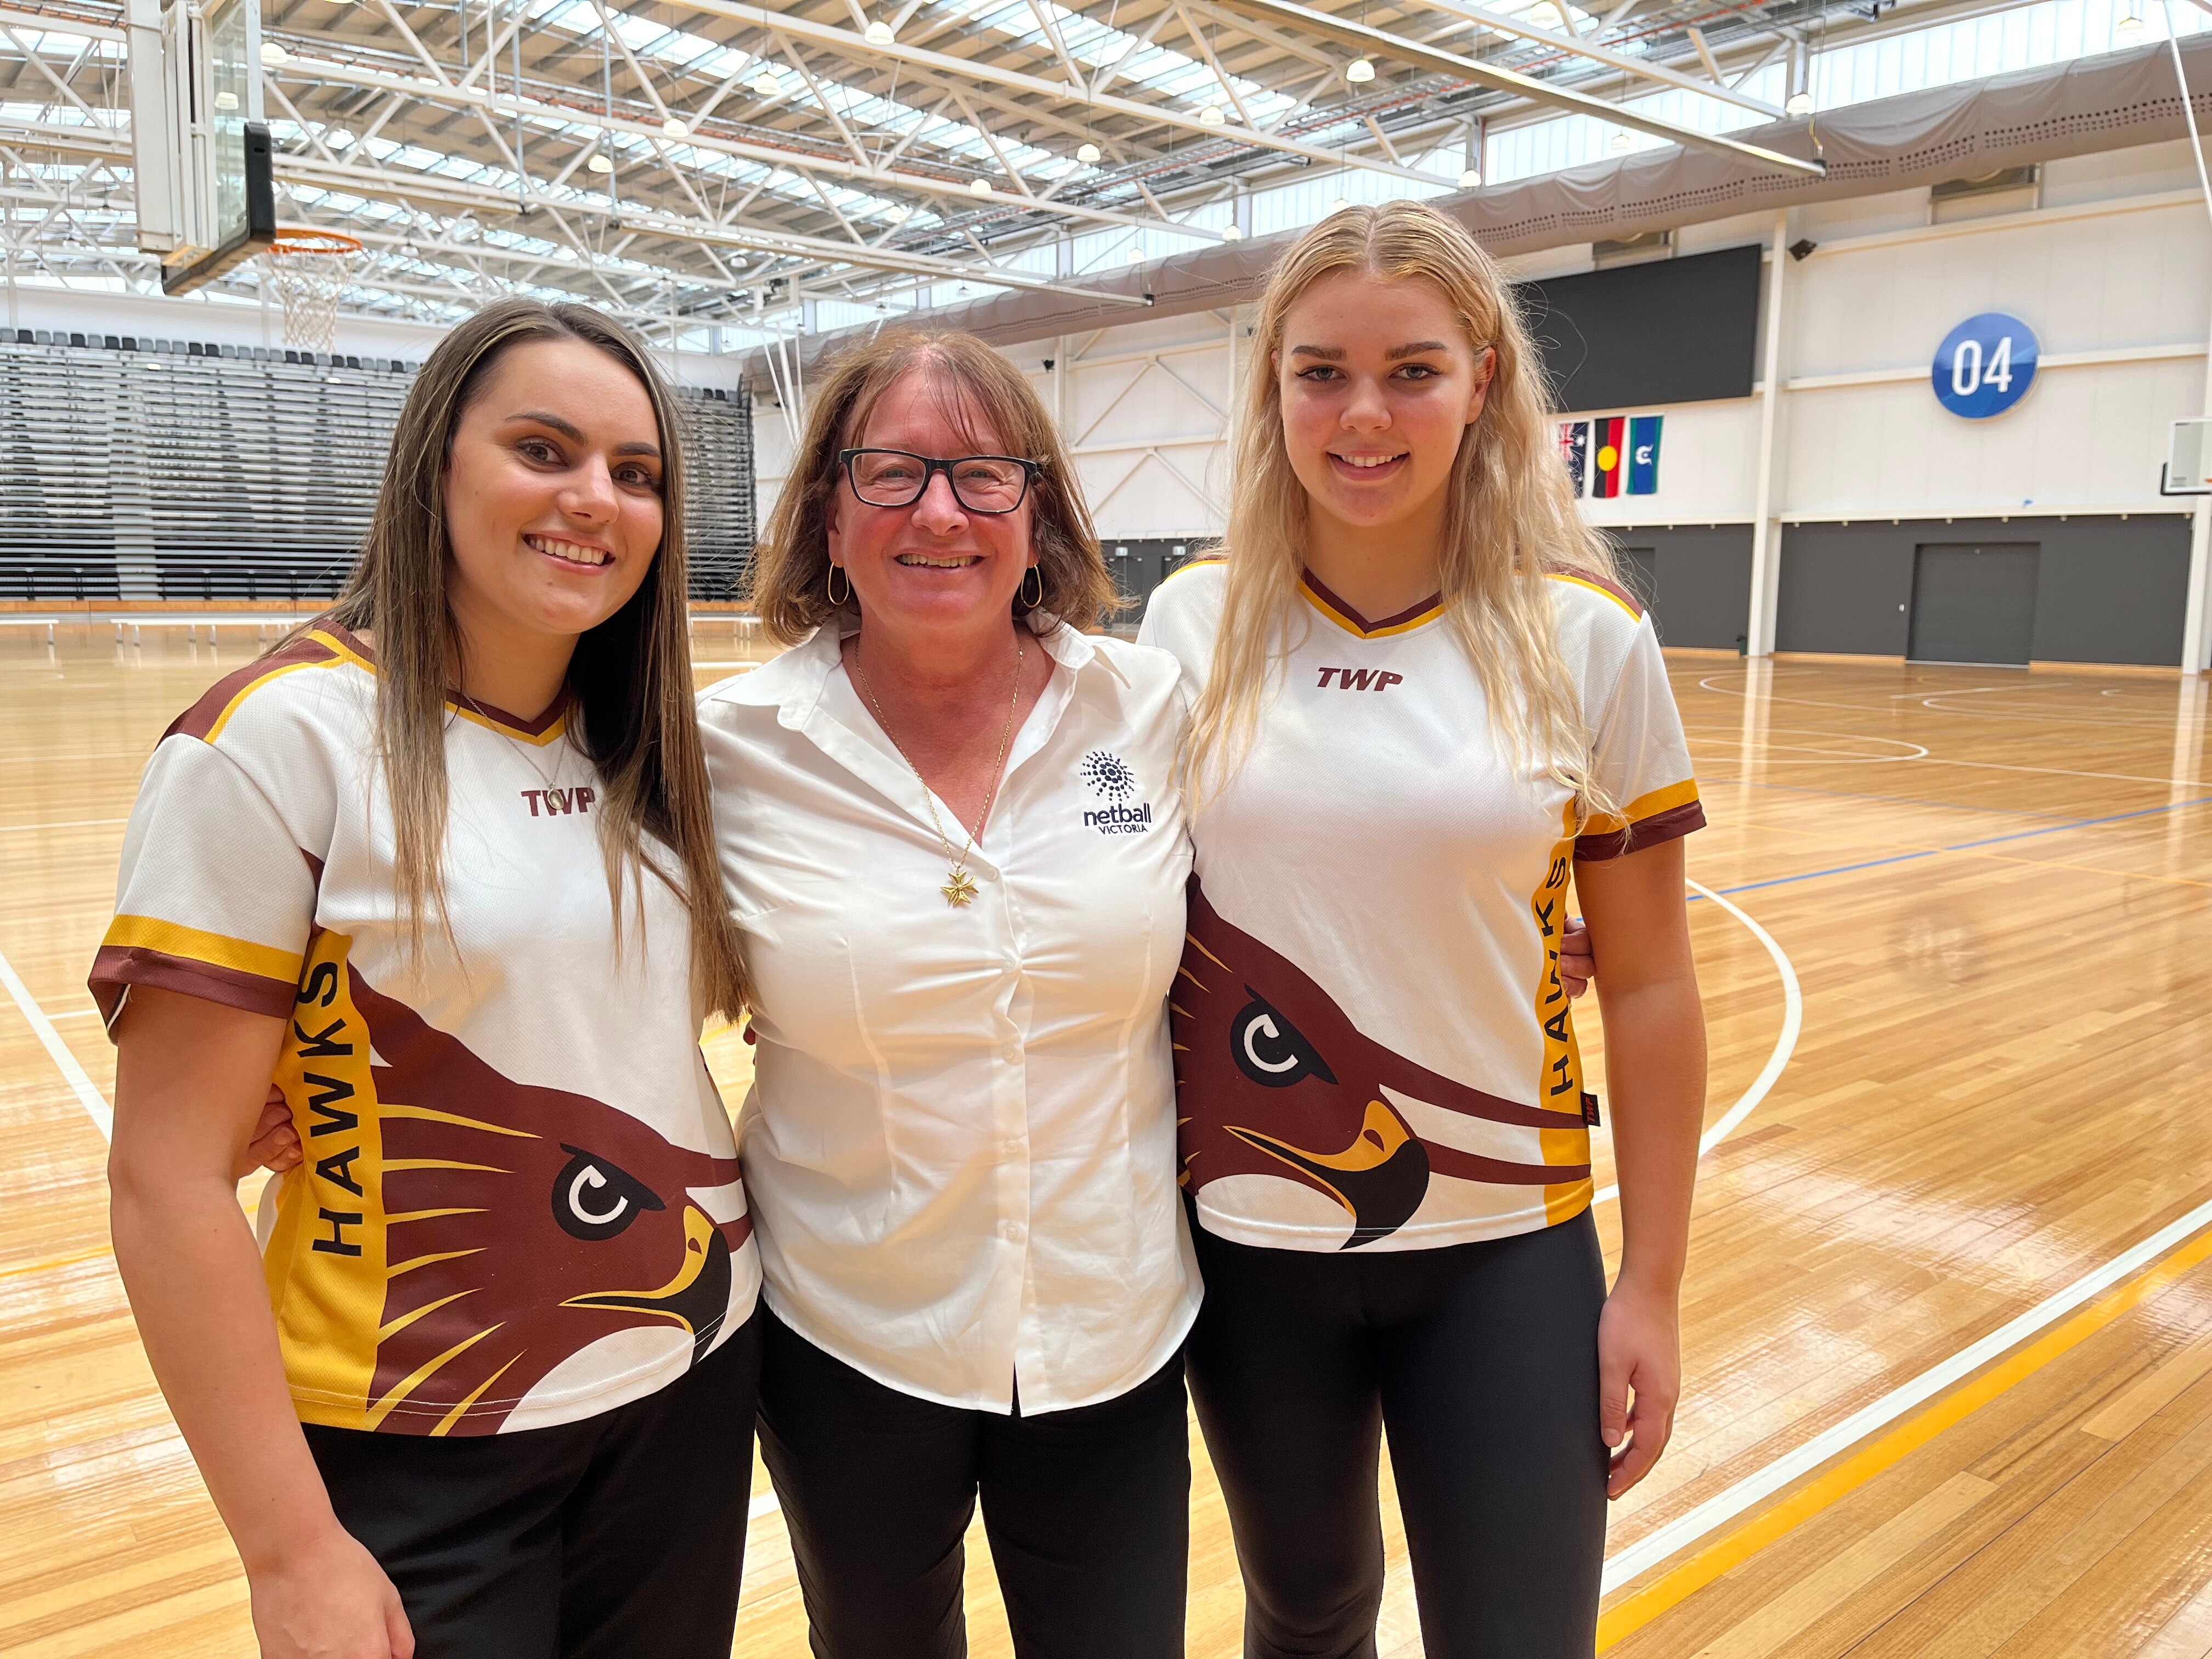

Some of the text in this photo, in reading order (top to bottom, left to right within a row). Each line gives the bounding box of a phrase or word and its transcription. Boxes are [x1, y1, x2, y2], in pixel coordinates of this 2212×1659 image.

[1951, 336, 2013, 396] 04
[1317, 667, 1403, 691] TWP
[521, 787, 596, 817] TWP
[1083, 803, 1152, 827] netball
[1098, 823, 1148, 835] VICTORIA
[294, 961, 363, 1257] HAWKS
